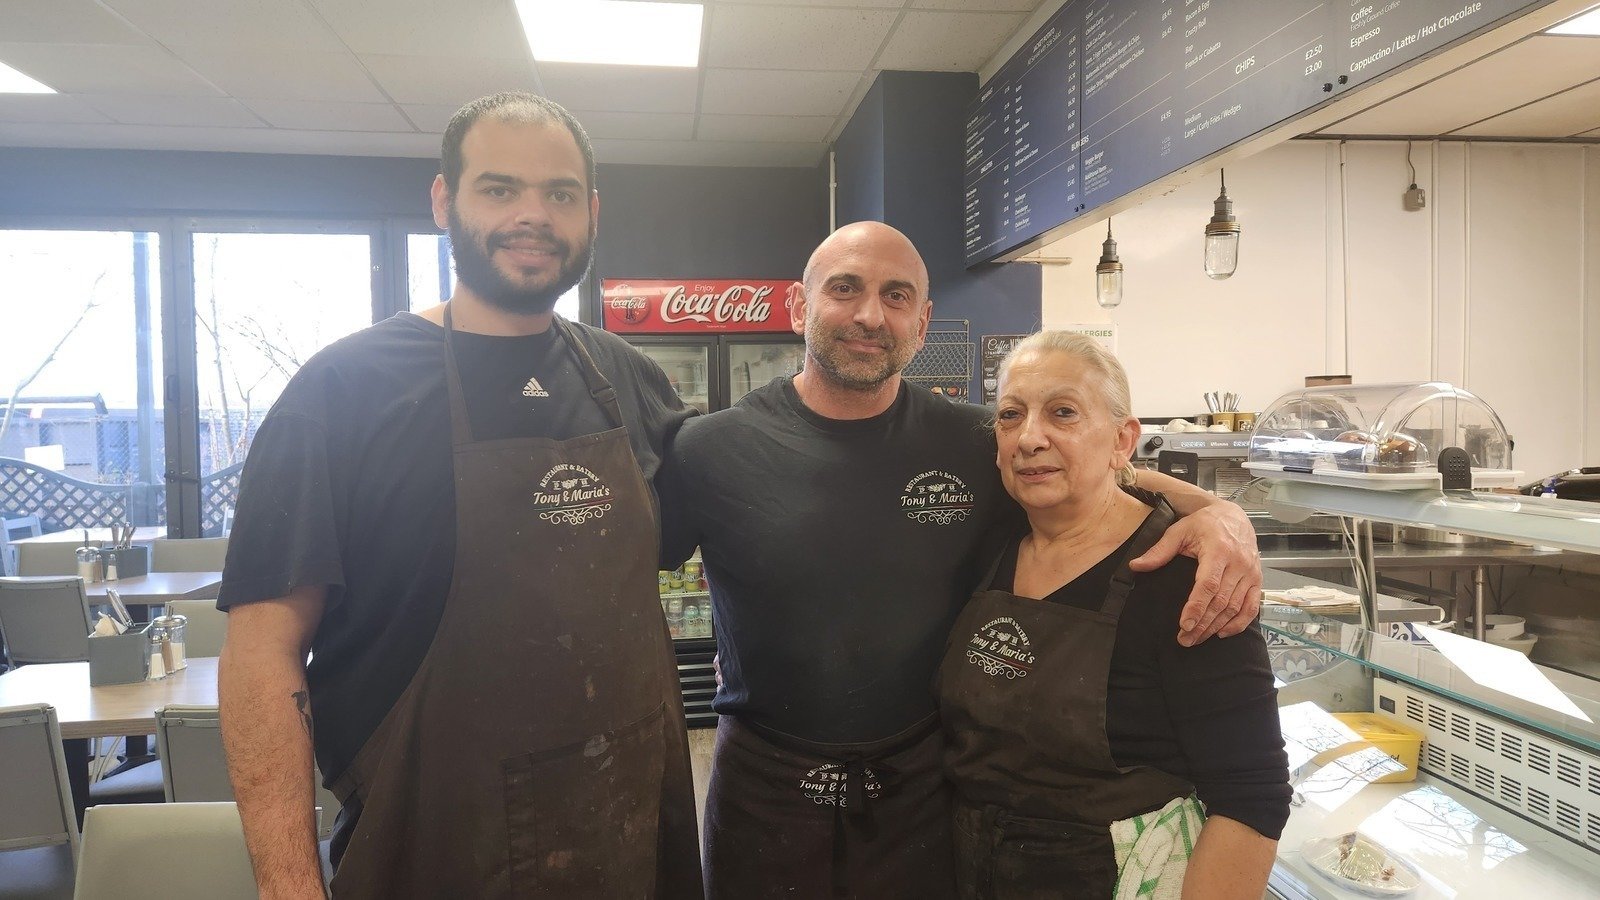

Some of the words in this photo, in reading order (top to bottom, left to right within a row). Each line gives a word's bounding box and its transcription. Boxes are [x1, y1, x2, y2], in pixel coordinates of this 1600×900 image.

[1351, 5, 1373, 23] Coffee
[1350, 46, 1391, 72] Cappuccino
[1396, 33, 1416, 51] Latte
[1422, 22, 1437, 39] Hot
[1438, 2, 1482, 29] Chocolate
[1350, 26, 1381, 48] Espresso
[1305, 44, 1323, 61] £2.50
[1235, 55, 1256, 75] CHIPS
[1304, 60, 1323, 76] £3.00
[694, 284, 715, 293] Enjoy
[610, 296, 647, 310] Coca-Cola
[660, 285, 774, 323] Coca-Cola
[522, 389, 549, 397] adidas
[904, 470, 938, 493] RESTAURANT
[943, 472, 967, 489] EATERY
[533, 491, 560, 506] Tony
[563, 490, 570, 502] &
[570, 485, 610, 502] Maria's
[900, 495, 926, 507] Tony
[929, 494, 937, 504] &
[938, 491, 974, 504] Maria's
[970, 633, 989, 650] Tony
[989, 640, 1000, 651] &
[996, 644, 1036, 664] Maria's
[799, 779, 826, 794] Tony
[828, 782, 837, 792] &
